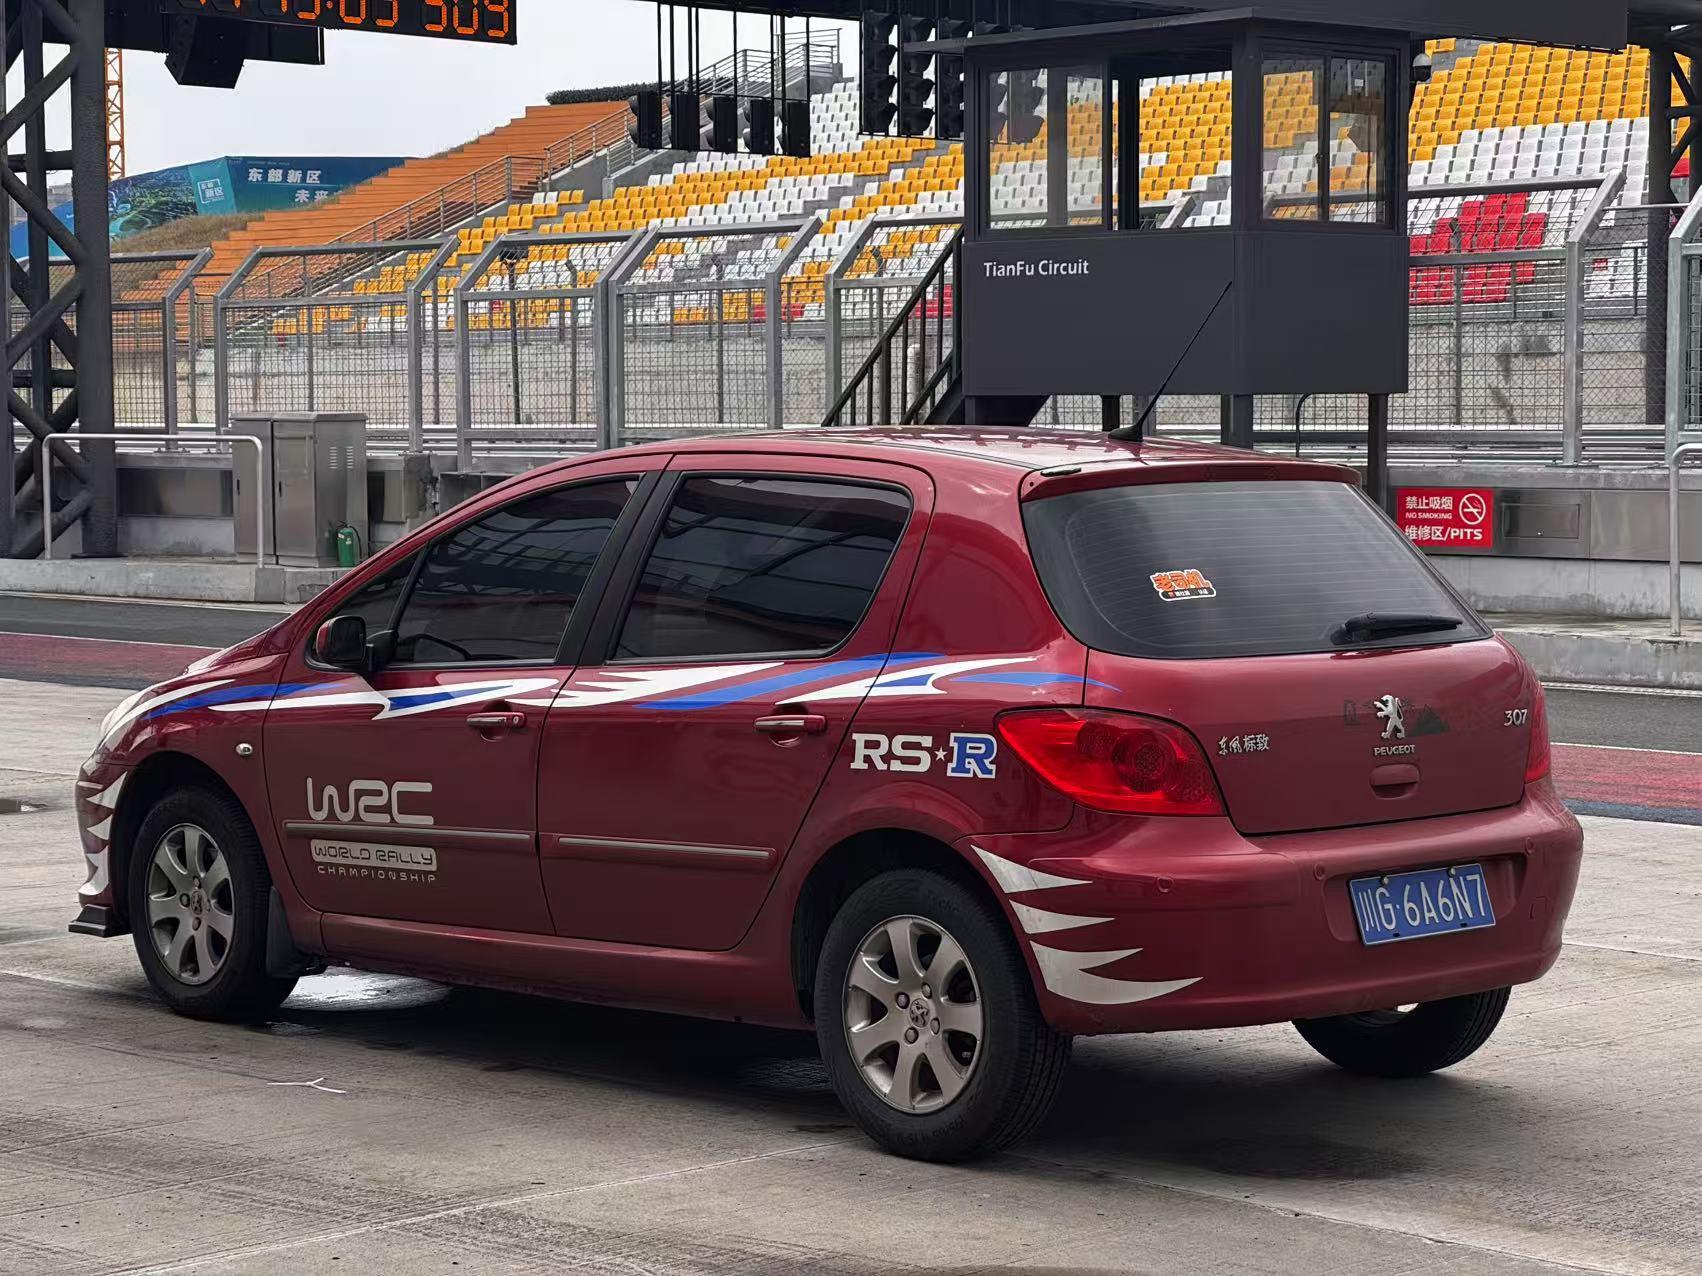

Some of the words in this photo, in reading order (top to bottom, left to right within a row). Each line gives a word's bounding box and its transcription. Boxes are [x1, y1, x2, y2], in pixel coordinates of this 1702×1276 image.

[247, 168, 322, 184] 东部新区
[295, 189, 343, 202] 未来
[983, 260, 1035, 277] TianFu
[1038, 259, 1089, 276] Circuit
[1405, 495, 1453, 510] 禁止吸烟
[1405, 512, 1417, 520] NO
[1418, 512, 1453, 520] SMOKING
[1405, 525, 1483, 541] 维修区/PITS
[1503, 708, 1528, 727] 307
[1218, 733, 1270, 756] 东风标致
[1373, 744, 1416, 757] PEUGEOT
[306, 777, 434, 825] WRC
[314, 845, 371, 861] WORLD
[376, 849, 433, 866] RALLY
[317, 865, 436, 883] CHAMPIONSHIP
